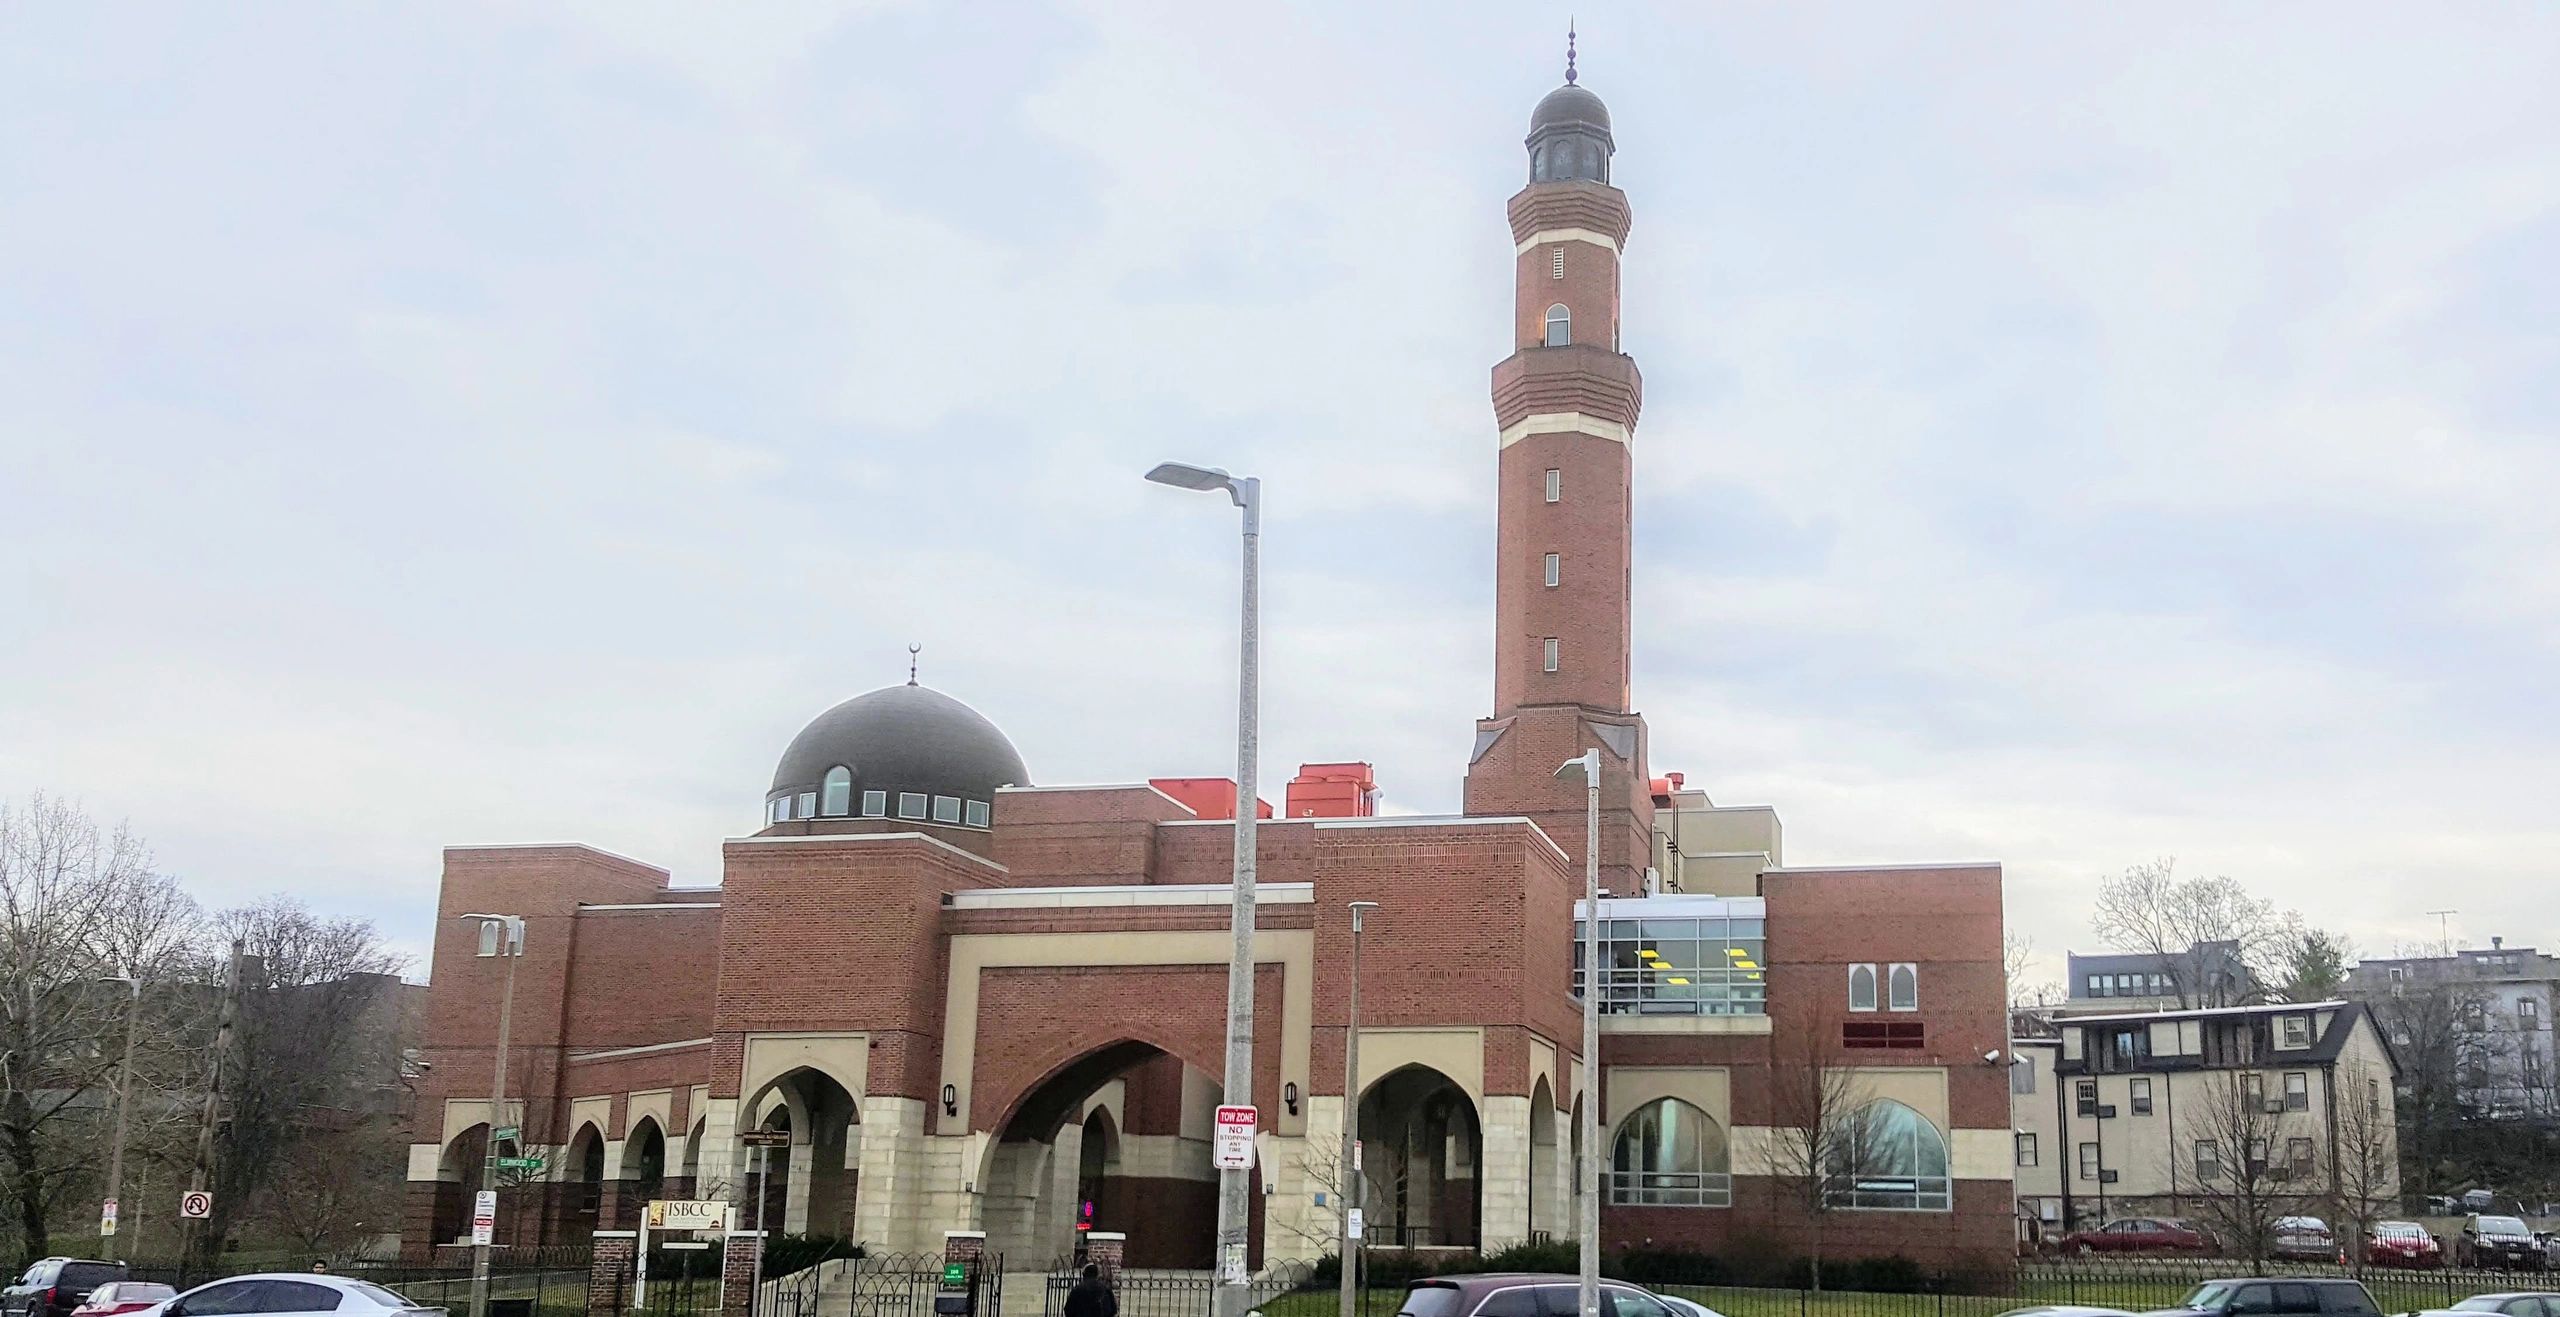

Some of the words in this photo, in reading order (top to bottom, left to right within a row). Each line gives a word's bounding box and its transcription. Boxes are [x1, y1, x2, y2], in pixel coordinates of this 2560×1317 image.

[1220, 1111, 1236, 1123] TOW
[1236, 1112, 1254, 1123] ZONE
[1229, 1126, 1243, 1134] NO
[668, 1202, 712, 1217] ISBCC
